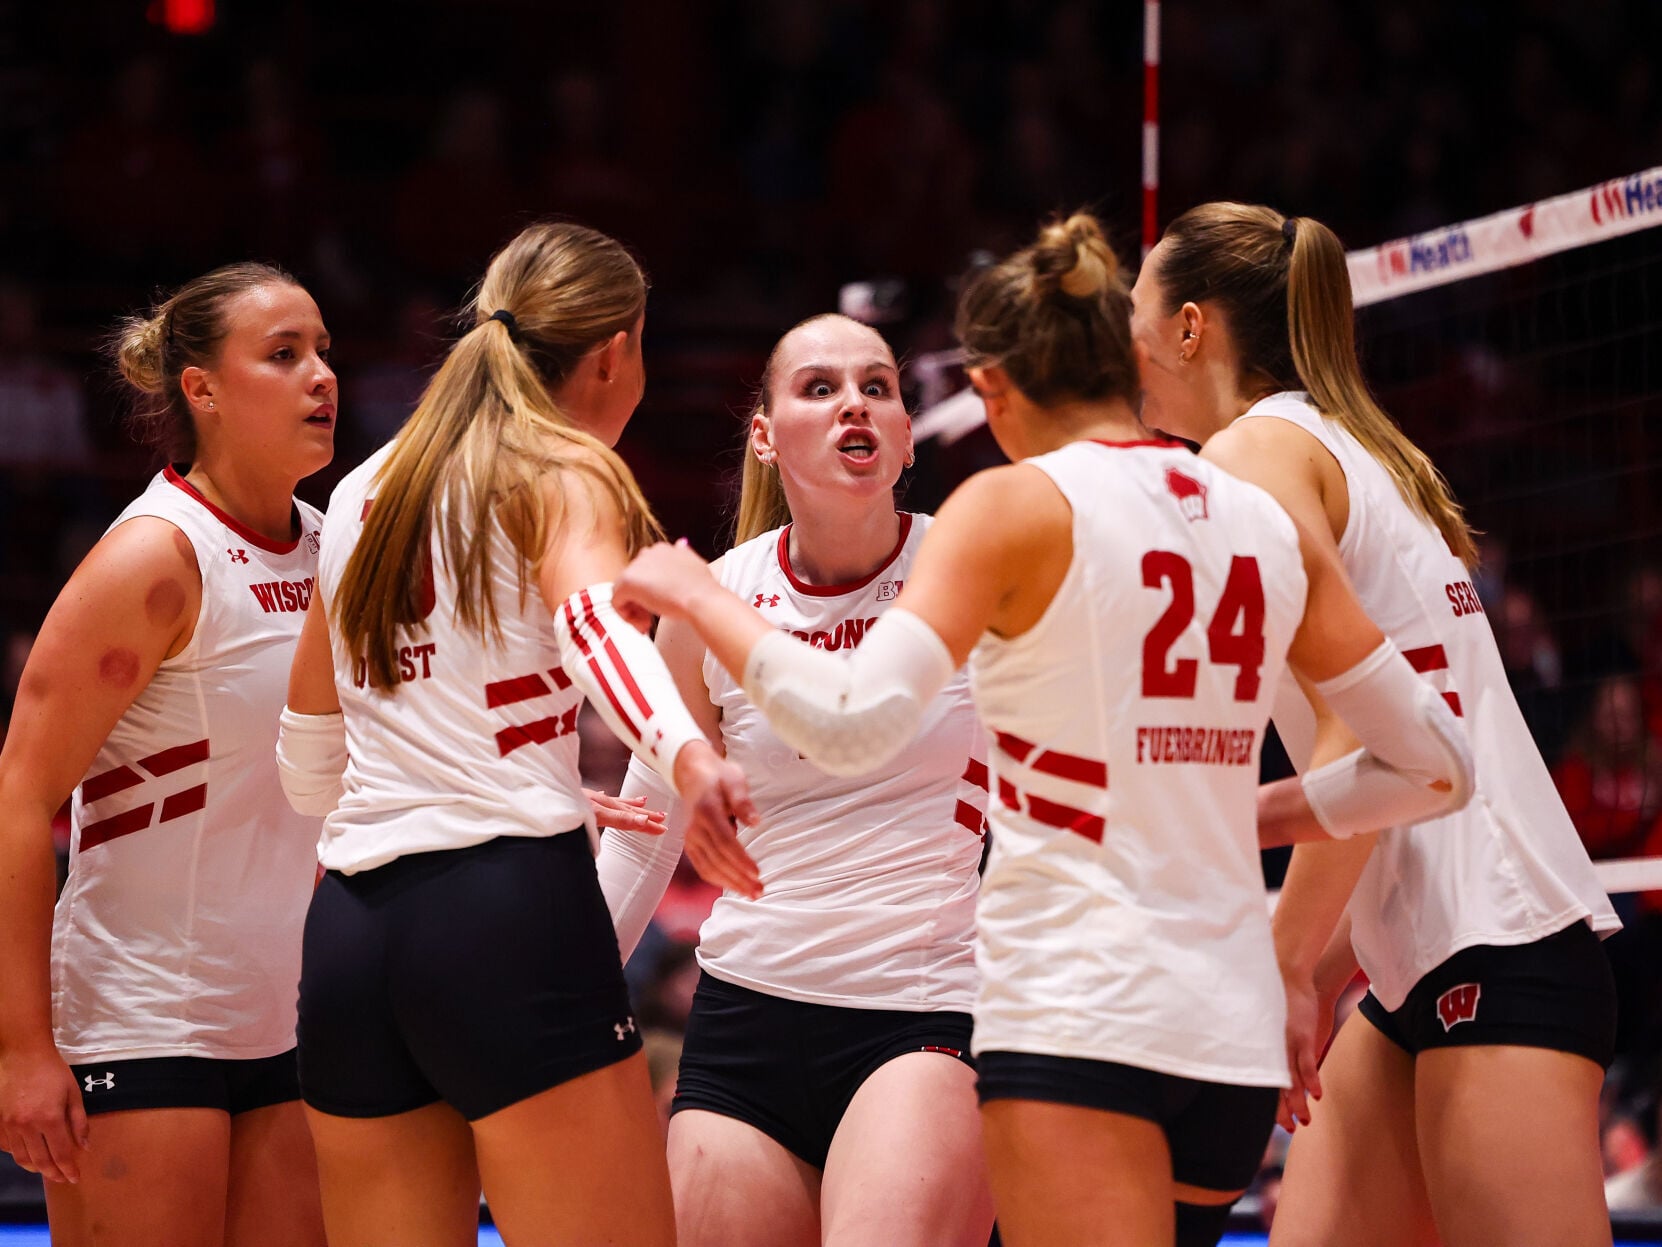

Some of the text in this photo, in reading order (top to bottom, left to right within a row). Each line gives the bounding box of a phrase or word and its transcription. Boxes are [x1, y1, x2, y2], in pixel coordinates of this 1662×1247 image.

[1140, 549, 1265, 702] 24
[1136, 726, 1256, 767] FUERBRINGER
[1437, 983, 1481, 1033] W
